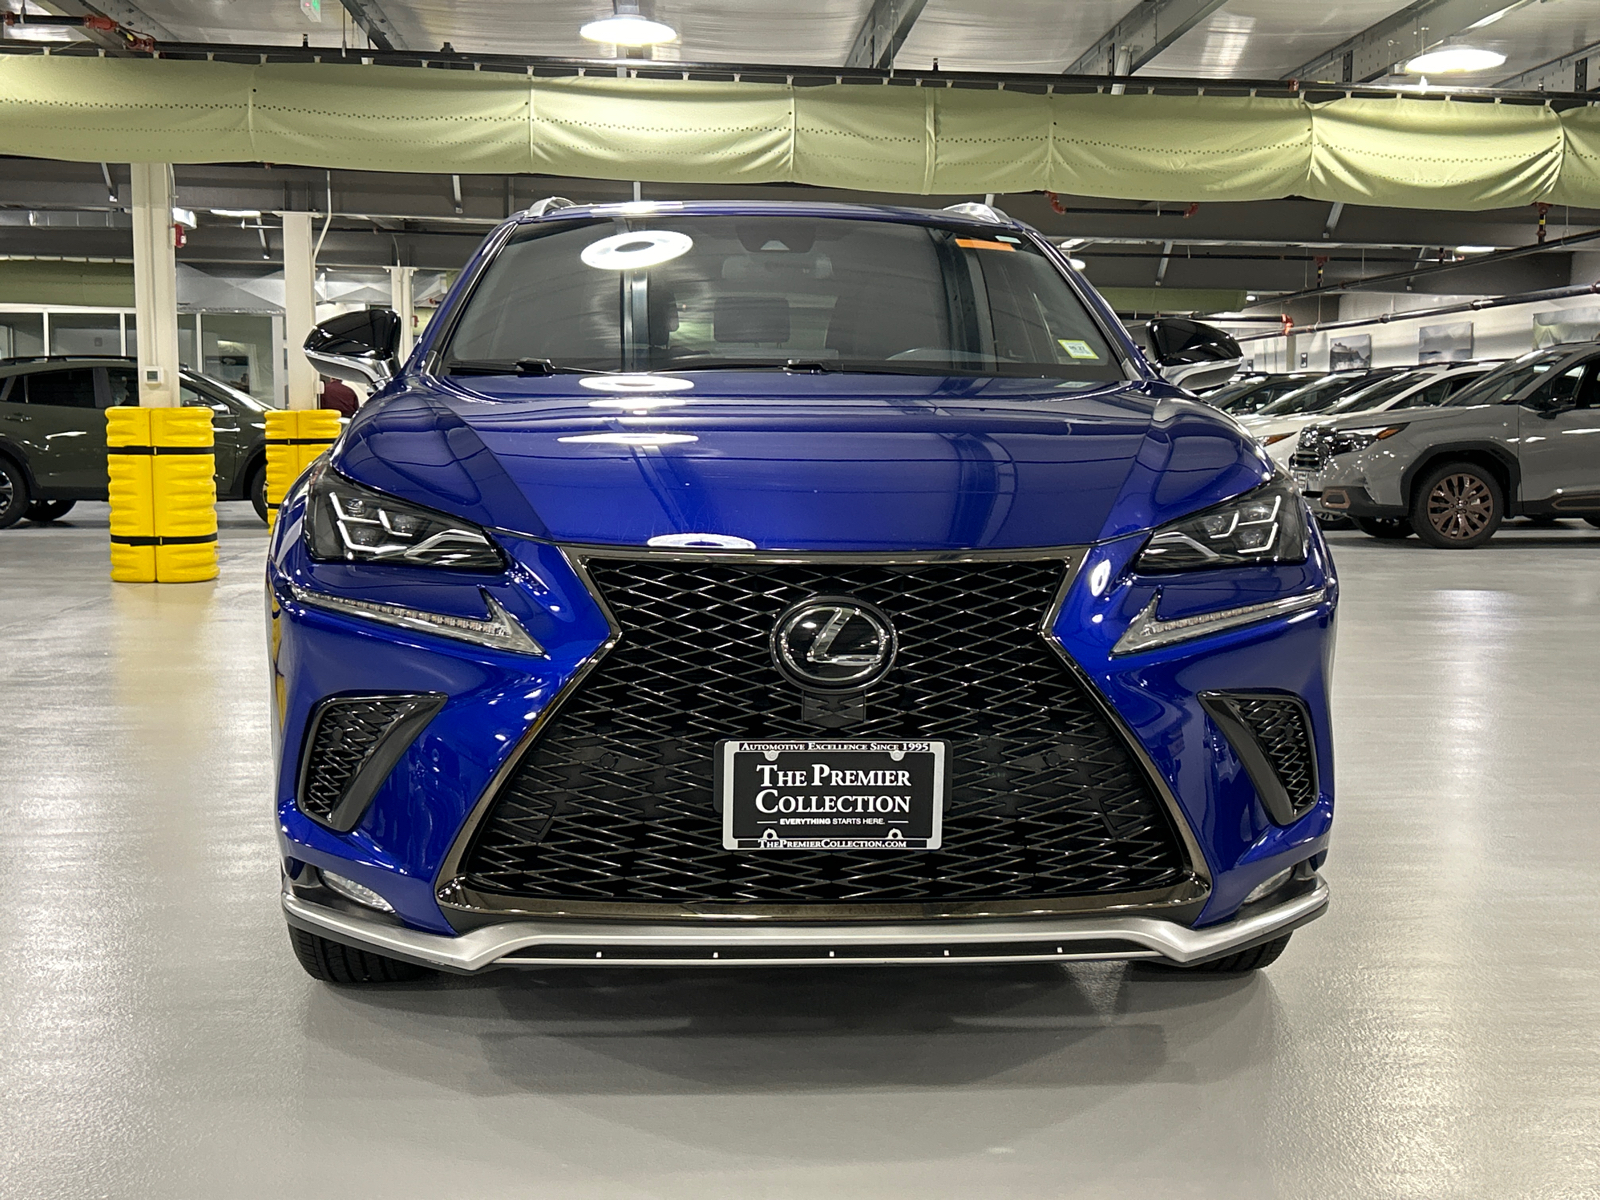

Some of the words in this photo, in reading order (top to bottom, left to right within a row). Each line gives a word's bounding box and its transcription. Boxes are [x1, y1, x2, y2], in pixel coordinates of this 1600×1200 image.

[741, 743, 805, 751] AUTOMOTIVE
[808, 743, 868, 751] EXCELLENCE
[870, 743, 900, 751] SINCE
[902, 743, 929, 751] 1995
[756, 764, 807, 787] THE
[811, 764, 912, 787] PREMIER
[755, 789, 911, 813] COLLECTION
[832, 817, 862, 825] STARTS
[757, 839, 907, 848] THEPREMIERCOLLECTION.COM
